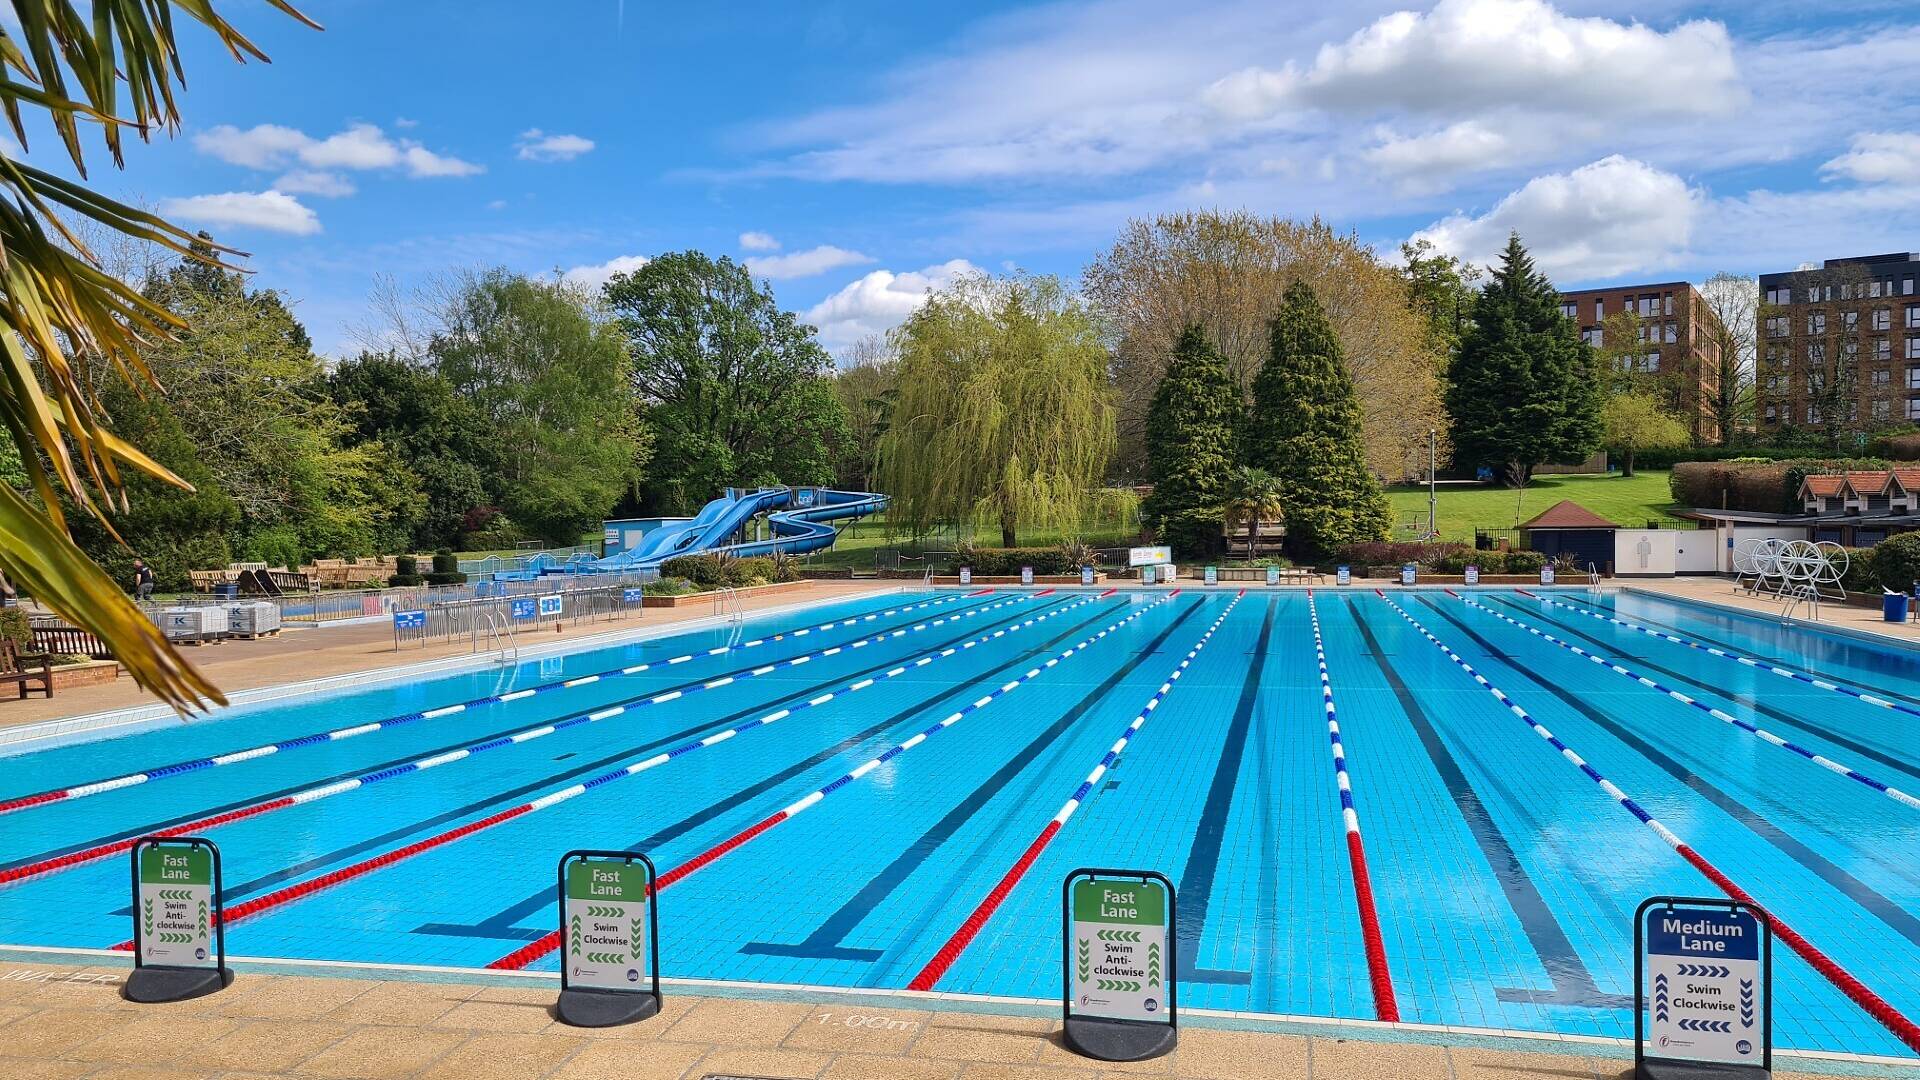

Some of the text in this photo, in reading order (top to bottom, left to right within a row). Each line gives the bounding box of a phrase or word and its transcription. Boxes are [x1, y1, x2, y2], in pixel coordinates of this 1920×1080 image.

[163, 854, 189, 867] Fast
[161, 867, 190, 880] Lane
[592, 868, 621, 883] Fast
[590, 882, 623, 896] Lane
[1103, 889, 1135, 905] Fast
[164, 901, 188, 910] Swim
[1100, 903, 1138, 919] Lane
[165, 911, 188, 920] Anti-
[156, 920, 196, 931] clockwise
[593, 922, 619, 933] Swim
[1662, 918, 1743, 937] Medium
[583, 934, 629, 946] Clockwise
[1680, 935, 1726, 952] Lane
[1104, 942, 1133, 954] Swim
[1105, 954, 1132, 966] Anti-
[1093, 965, 1145, 978] clockwise
[1686, 983, 1722, 996] Swim
[1672, 997, 1736, 1012] Clockwise
